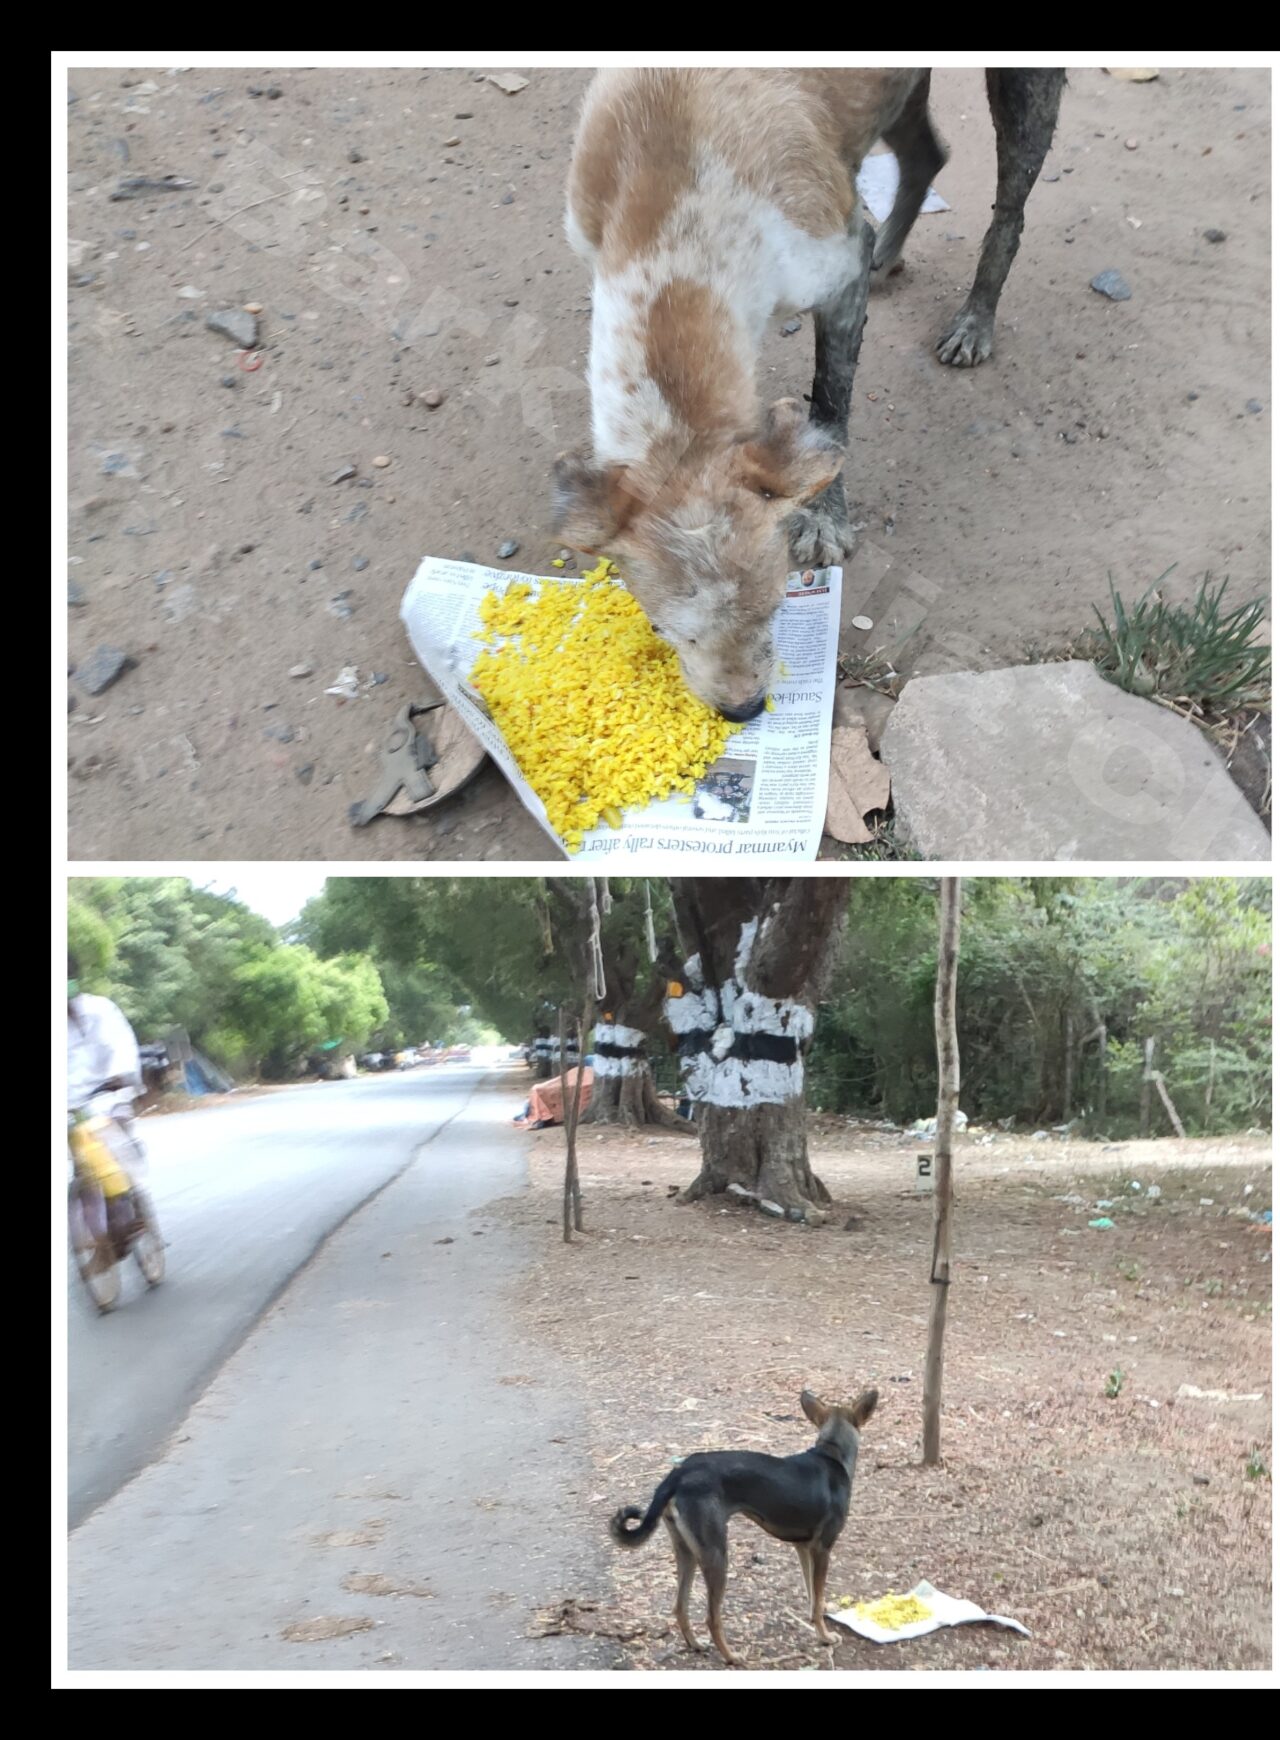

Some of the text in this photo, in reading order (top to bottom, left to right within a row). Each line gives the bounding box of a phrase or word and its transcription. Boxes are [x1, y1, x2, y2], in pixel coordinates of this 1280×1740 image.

[589, 837, 622, 855] after
[625, 835, 654, 853] rally
[658, 838, 733, 855] protesters
[736, 839, 808, 854] Myanmar
[919, 1158, 931, 1176] 2
